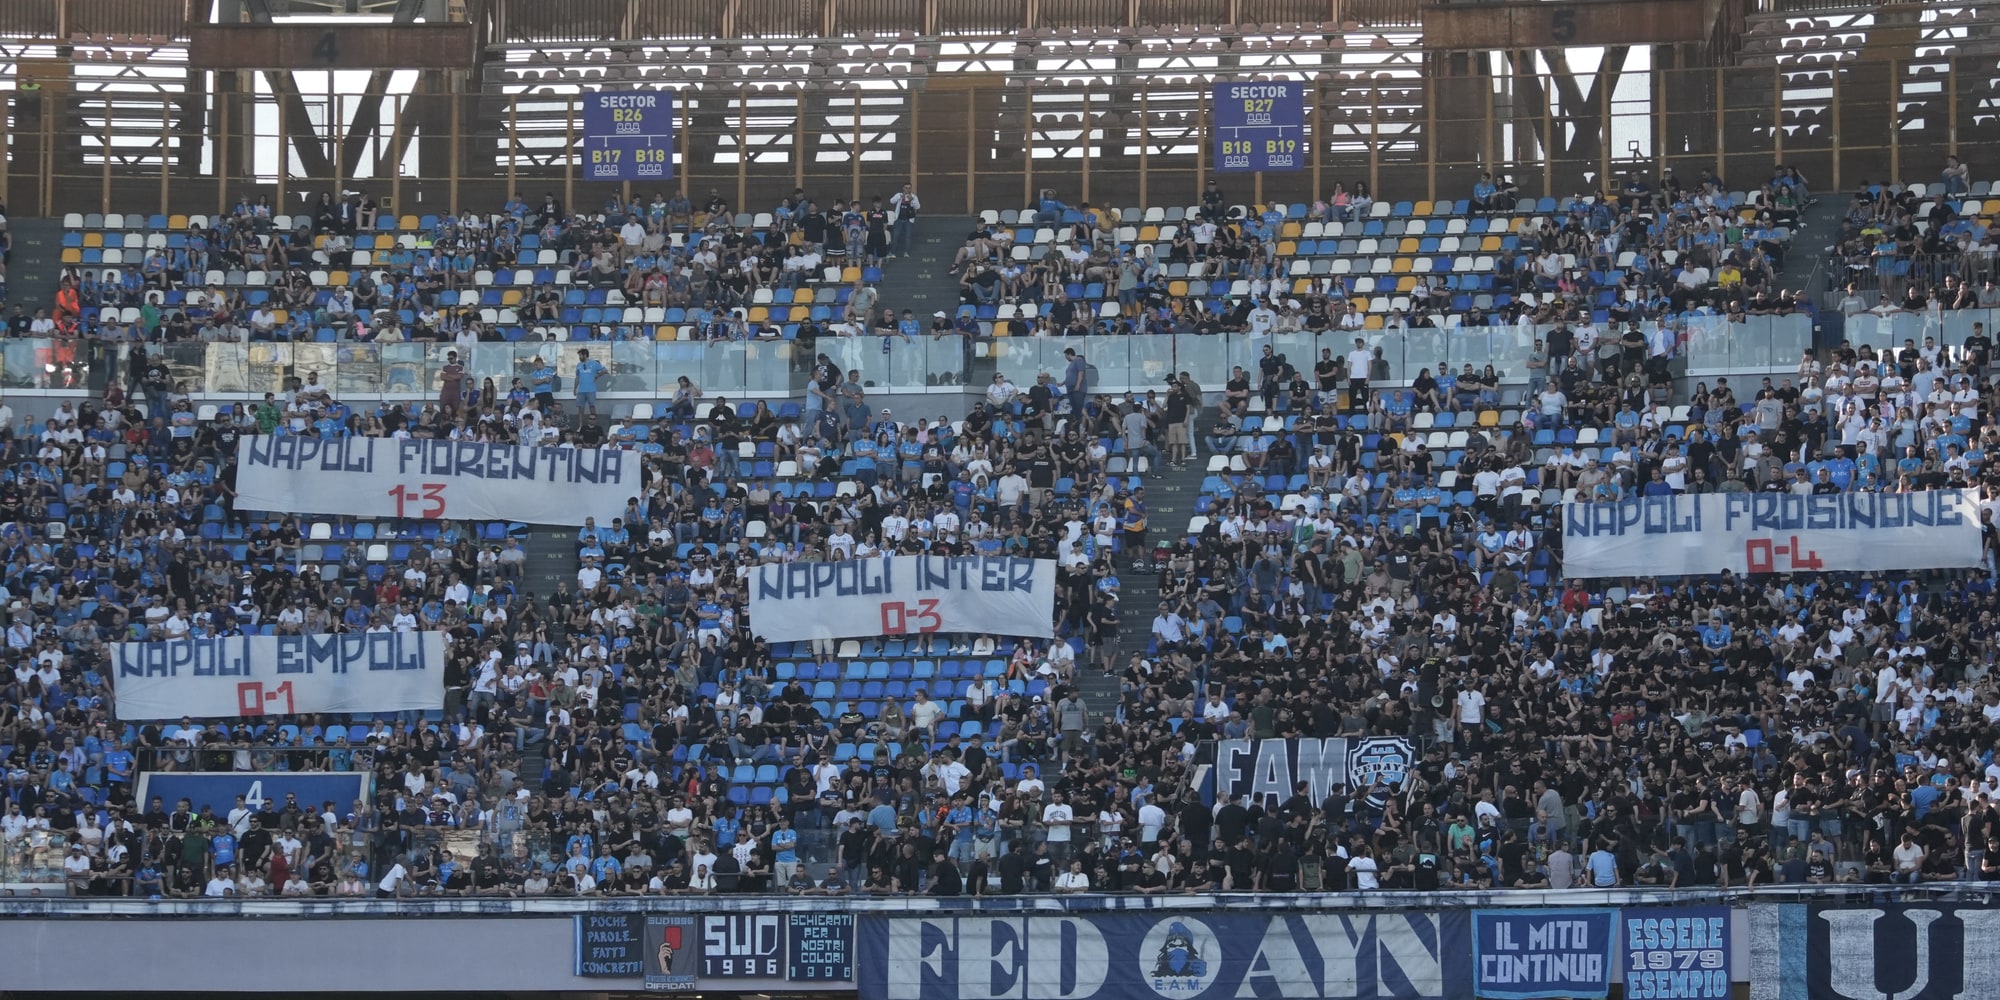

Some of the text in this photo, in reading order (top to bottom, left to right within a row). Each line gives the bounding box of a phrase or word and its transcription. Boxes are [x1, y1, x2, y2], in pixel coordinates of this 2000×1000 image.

[1552, 9, 1577, 42] 5
[311, 31, 340, 64] 4
[600, 95, 656, 108] SECTOR
[1231, 85, 1287, 99] SECTOR
[1244, 99, 1274, 113] B27
[613, 108, 643, 122] B26
[592, 149, 665, 163] B17 B18
[1222, 140, 1296, 155] B18 B19
[248, 436, 623, 484] NAPOLI FIORENTINA
[387, 483, 448, 519] 1-3
[1567, 489, 1963, 537] NAPOLI FROSINONE
[1746, 536, 1823, 573] 0-4
[759, 554, 1035, 600] NAPOLI INTER
[880, 598, 942, 635] 0-3
[119, 631, 427, 678] NAPOLI EMPOLI
[237, 681, 294, 716] 0-1
[245, 780, 265, 810] 4
[590, 915, 628, 928] POCHE
[704, 914, 779, 956] SUD
[790, 914, 852, 926] SCHIERATI
[804, 926, 829, 939] PER
[1627, 917, 1725, 950] ESSERE
[800, 939, 845, 952] NOSTRI
[1496, 920, 1589, 951] IL MITO
[704, 959, 778, 975] 1996
[800, 952, 845, 964] COLORI
[887, 917, 1110, 1000] FED
[1481, 953, 1603, 984] CONTINUA
[1630, 950, 1725, 970] 1979
[645, 982, 695, 990] DIFFIDATI
[1154, 978, 1205, 991] E.A.M.
[1627, 970, 1729, 1000] ESEMPIO
